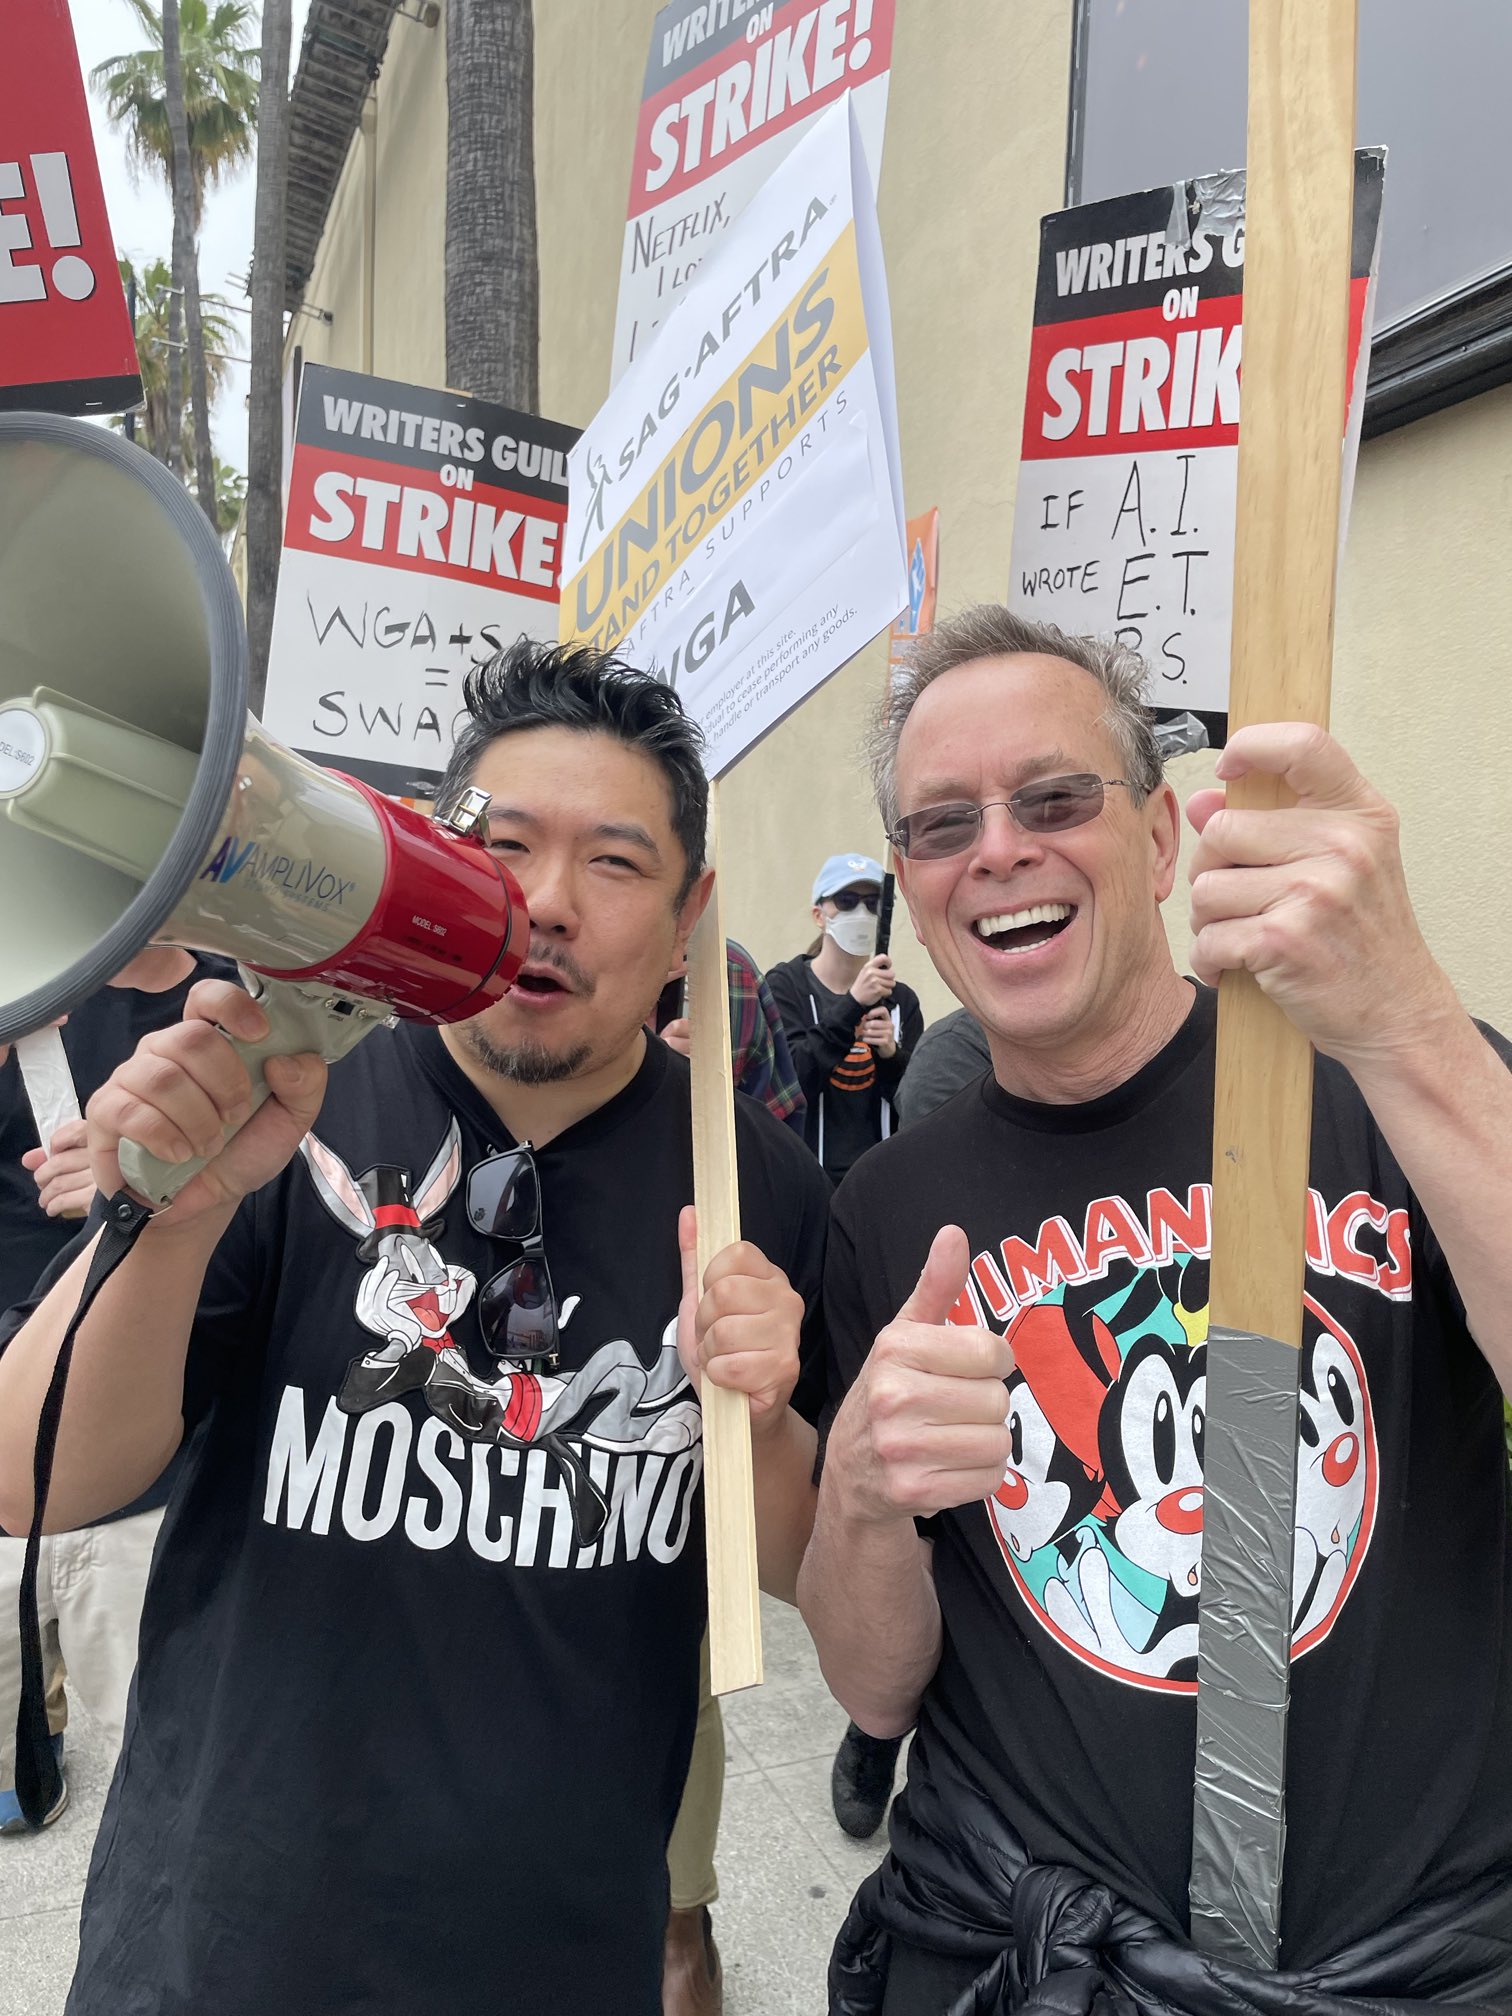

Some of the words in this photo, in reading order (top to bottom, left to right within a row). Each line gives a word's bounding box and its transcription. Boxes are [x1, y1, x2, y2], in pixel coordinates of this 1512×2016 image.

[662, 0, 763, 68] WRIT
[746, 2, 774, 44] ON
[645, 0, 874, 193] STRIKE!
[1055, 227, 1214, 297] WRITERS
[1162, 285, 1199, 321] ON
[1041, 324, 1243, 441] STRIK
[322, 395, 485, 462] WRITERS
[491, 435, 568, 487] GUIL
[440, 463, 474, 491] ON
[576, 266, 836, 633] UNIONS
[705, 391, 848, 560] SUPPORTS
[309, 471, 566, 590] STRIKE
[588, 559, 660, 651] TAND
[664, 344, 843, 566] TOGETHER
[1040, 490, 1084, 530] IF
[1110, 454, 1198, 547] A.I.
[1022, 560, 1100, 597] WROTE
[1117, 550, 1210, 621] E.T.
[705, 674, 745, 721] employer
[746, 665, 756, 683] at
[757, 648, 775, 669] this
[713, 709, 743, 742] handle
[743, 698, 755, 713] or
[755, 654, 801, 701] transport
[802, 637, 821, 660] any
[823, 606, 858, 645] goods.
[726, 701, 736, 716] to
[737, 674, 762, 704] cease
[764, 623, 819, 682] performing
[820, 602, 839, 627] any
[263, 1385, 703, 1569] MOSCHINO
